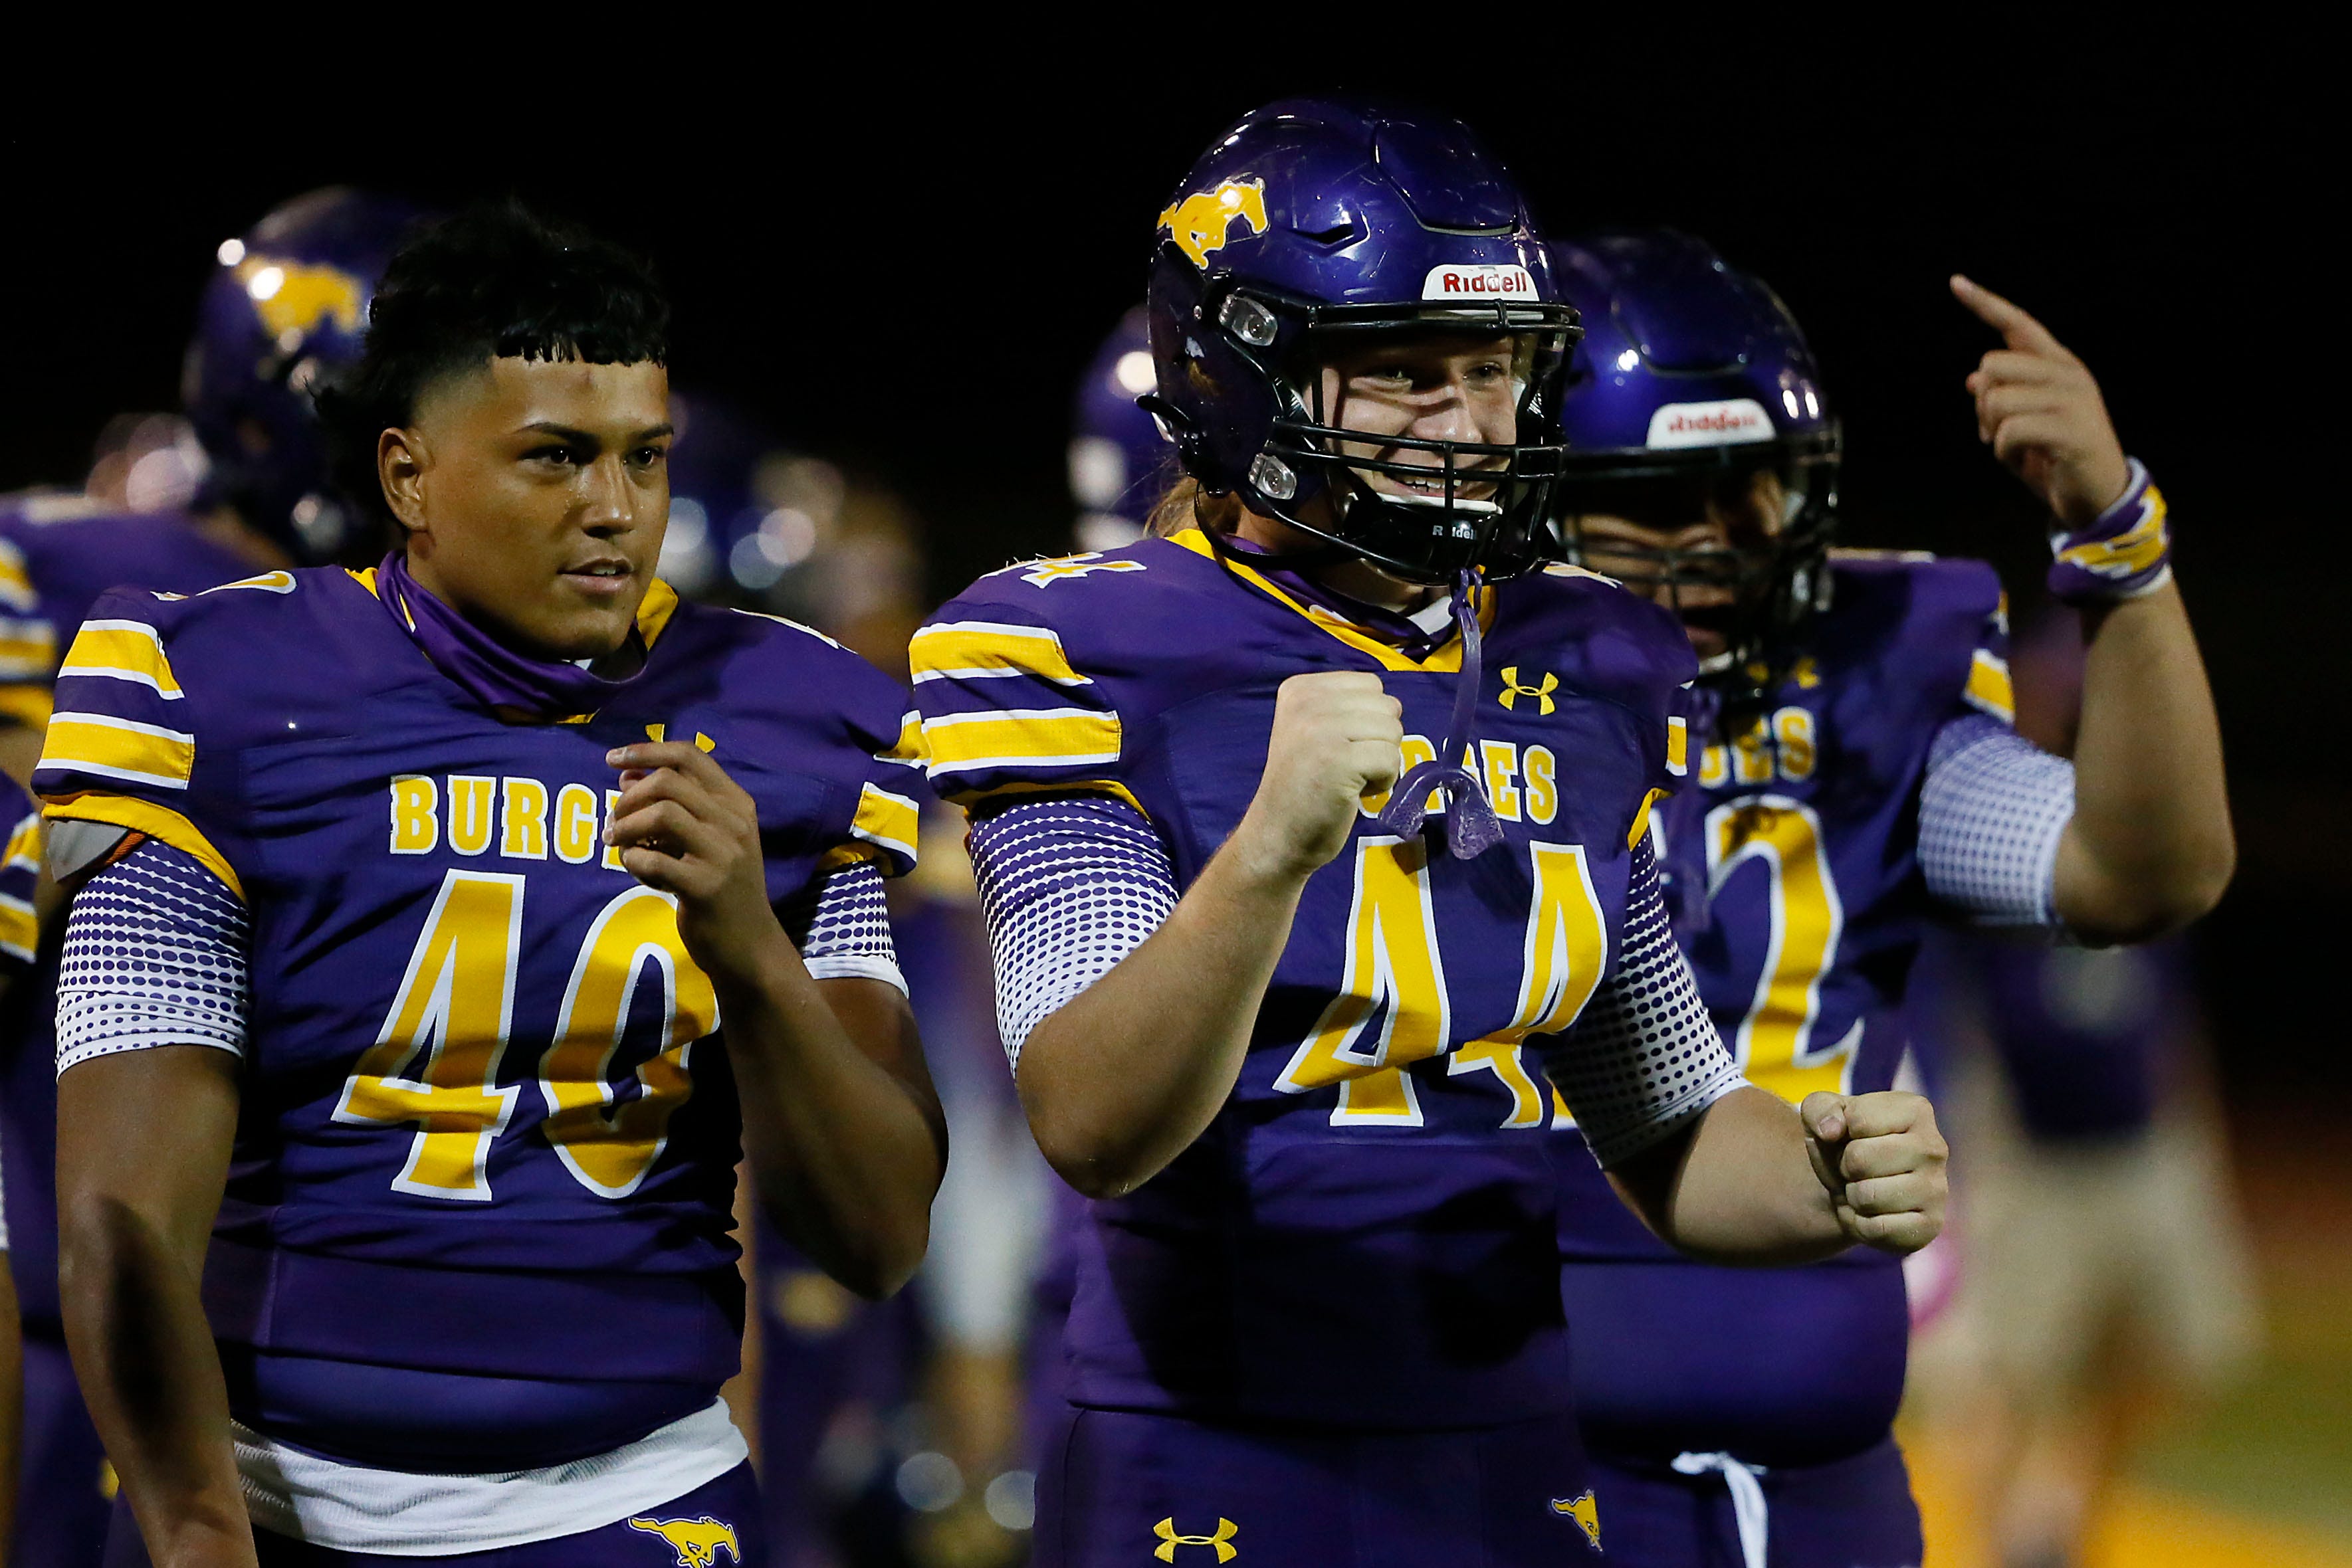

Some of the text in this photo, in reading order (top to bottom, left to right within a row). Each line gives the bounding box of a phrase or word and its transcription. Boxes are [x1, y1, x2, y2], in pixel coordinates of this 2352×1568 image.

[1443, 271, 1527, 292] Riddell
[389, 774, 628, 872] BURG
[331, 868, 721, 1201] 40
[1272, 835, 1608, 1129] 44
